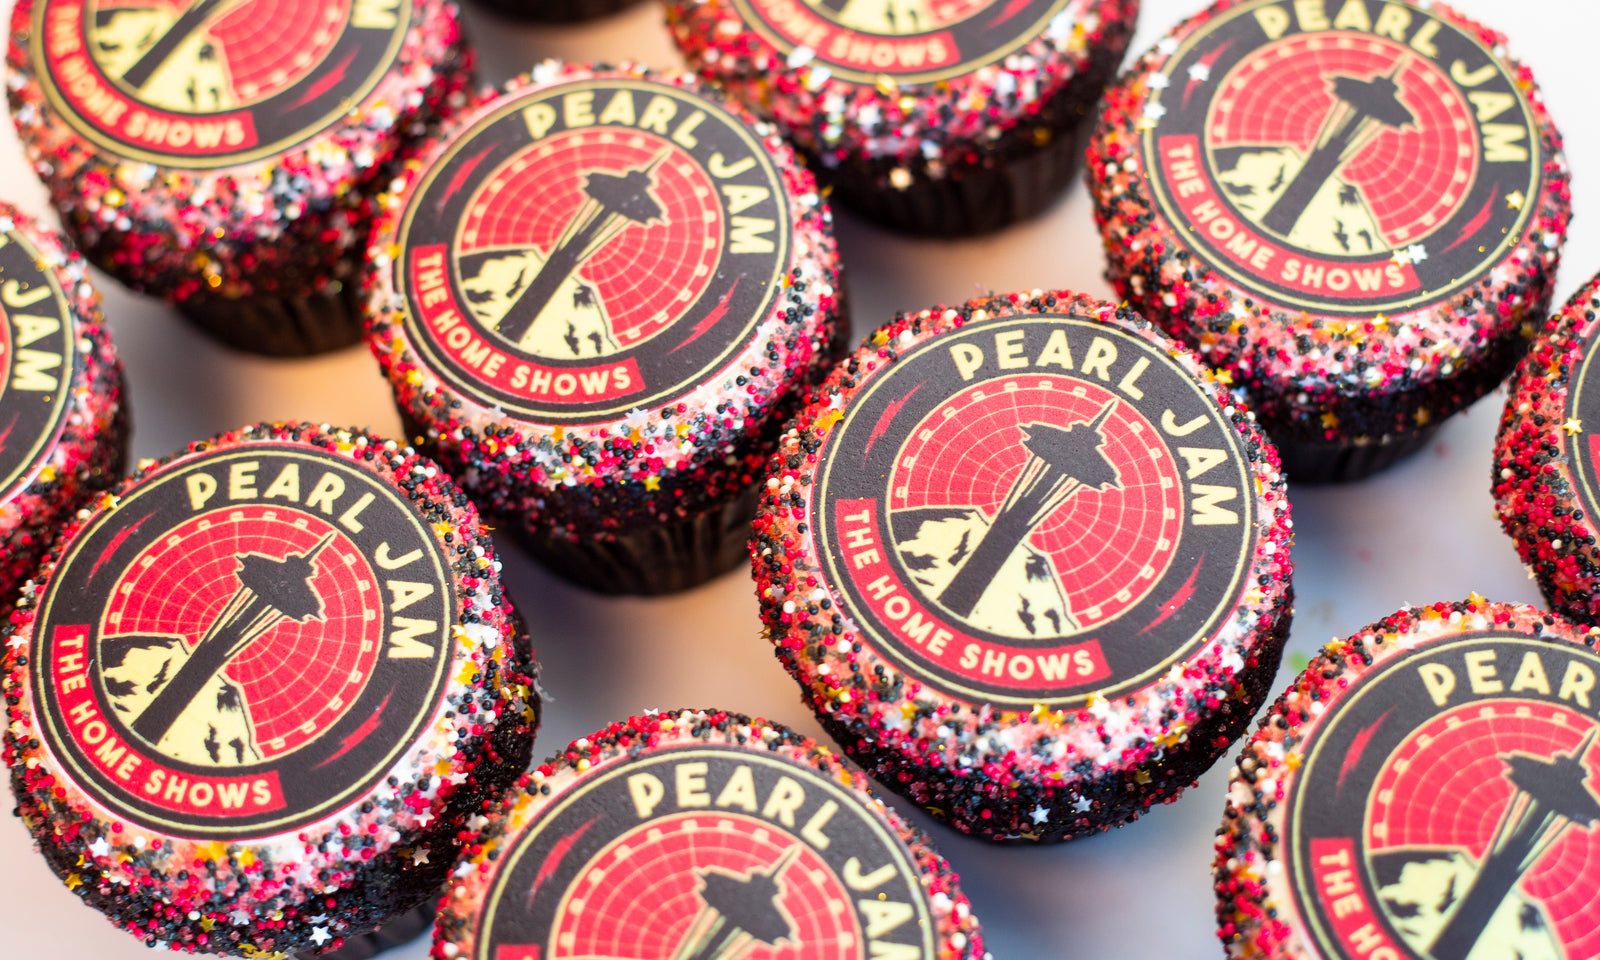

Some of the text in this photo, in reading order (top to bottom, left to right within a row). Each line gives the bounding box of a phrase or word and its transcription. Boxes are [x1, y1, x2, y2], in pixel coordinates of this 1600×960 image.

[58, 54, 128, 126] HOME
[124, 110, 246, 148] SHOWS
[759, 0, 948, 67] OME SHOWS
[1254, 0, 1529, 162] PEARL JAM
[523, 91, 775, 254] PEARL JAM
[1168, 144, 1405, 291] THE HOME SHOWS
[2, 279, 62, 391] JAM
[417, 252, 631, 396] THE HOME SHOWS
[949, 330, 1239, 526] PEARL JAM
[186, 462, 435, 660] PEARL JAM
[843, 509, 1095, 681] THE HOME SHOWS
[58, 634, 272, 808] THE HOME SHOWS
[1417, 650, 1600, 719] PEAR
[627, 762, 841, 851] PEARL
[1320, 849, 1363, 919] THE
